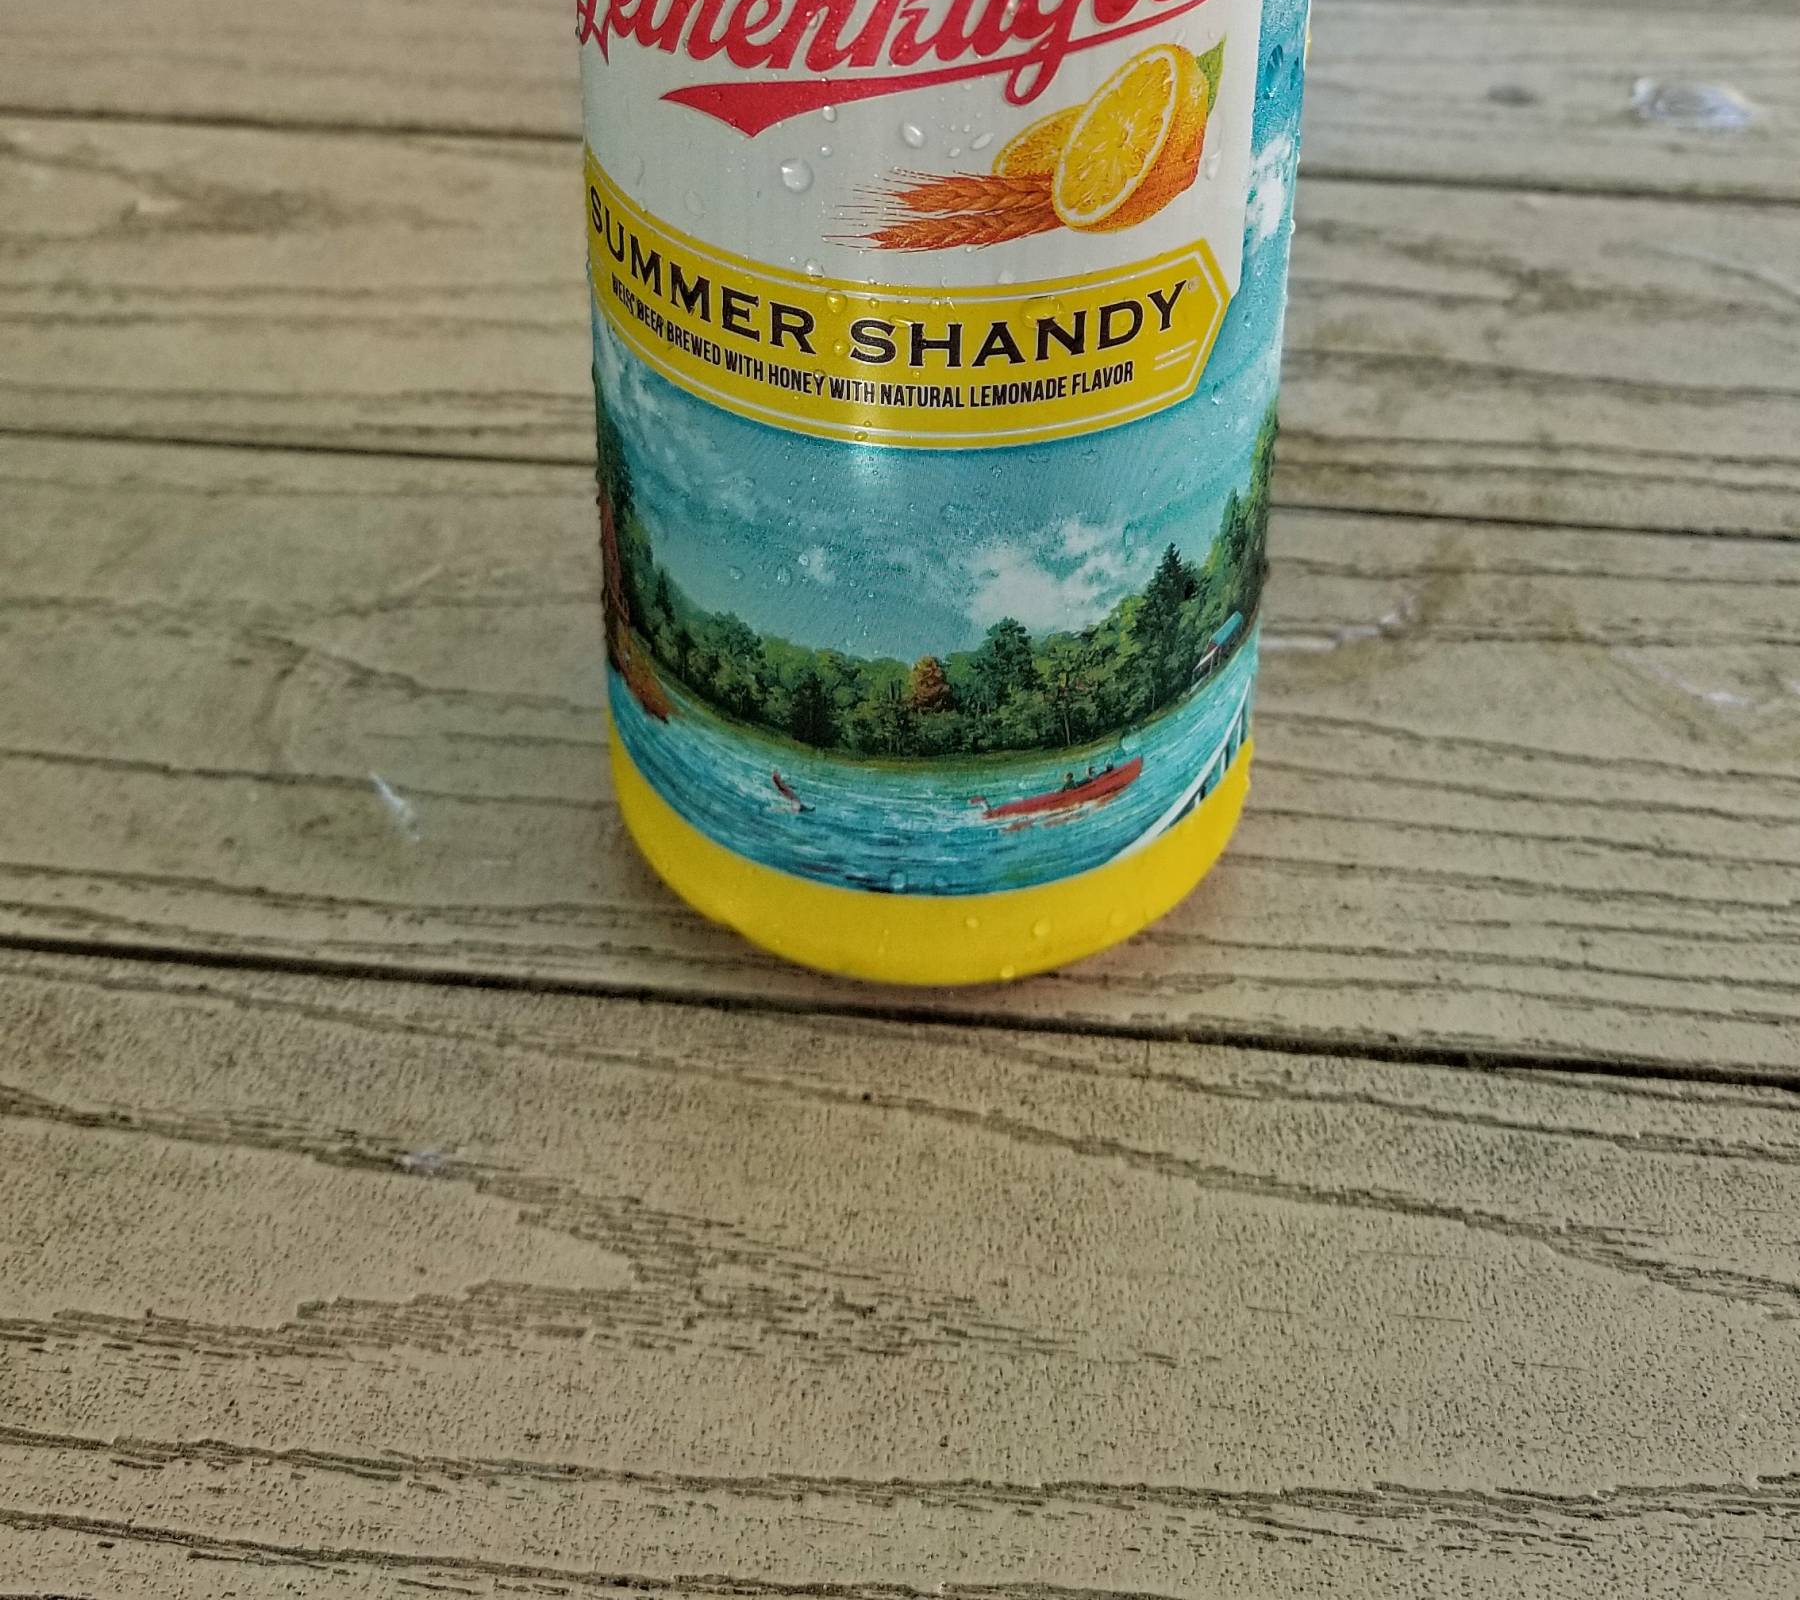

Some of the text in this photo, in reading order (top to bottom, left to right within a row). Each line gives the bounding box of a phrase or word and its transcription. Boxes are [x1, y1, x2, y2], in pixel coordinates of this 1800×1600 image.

[590, 185, 1187, 367] SUMMER SHANDY
[637, 299, 664, 338] BEER
[666, 319, 721, 366] BREWED
[724, 348, 764, 382] WITH
[768, 365, 826, 396] HONEY
[829, 376, 876, 405] WITH
[880, 384, 965, 408] NATURAL
[970, 376, 1067, 408] LEMONADE
[1072, 360, 1134, 396] FLAVOR
